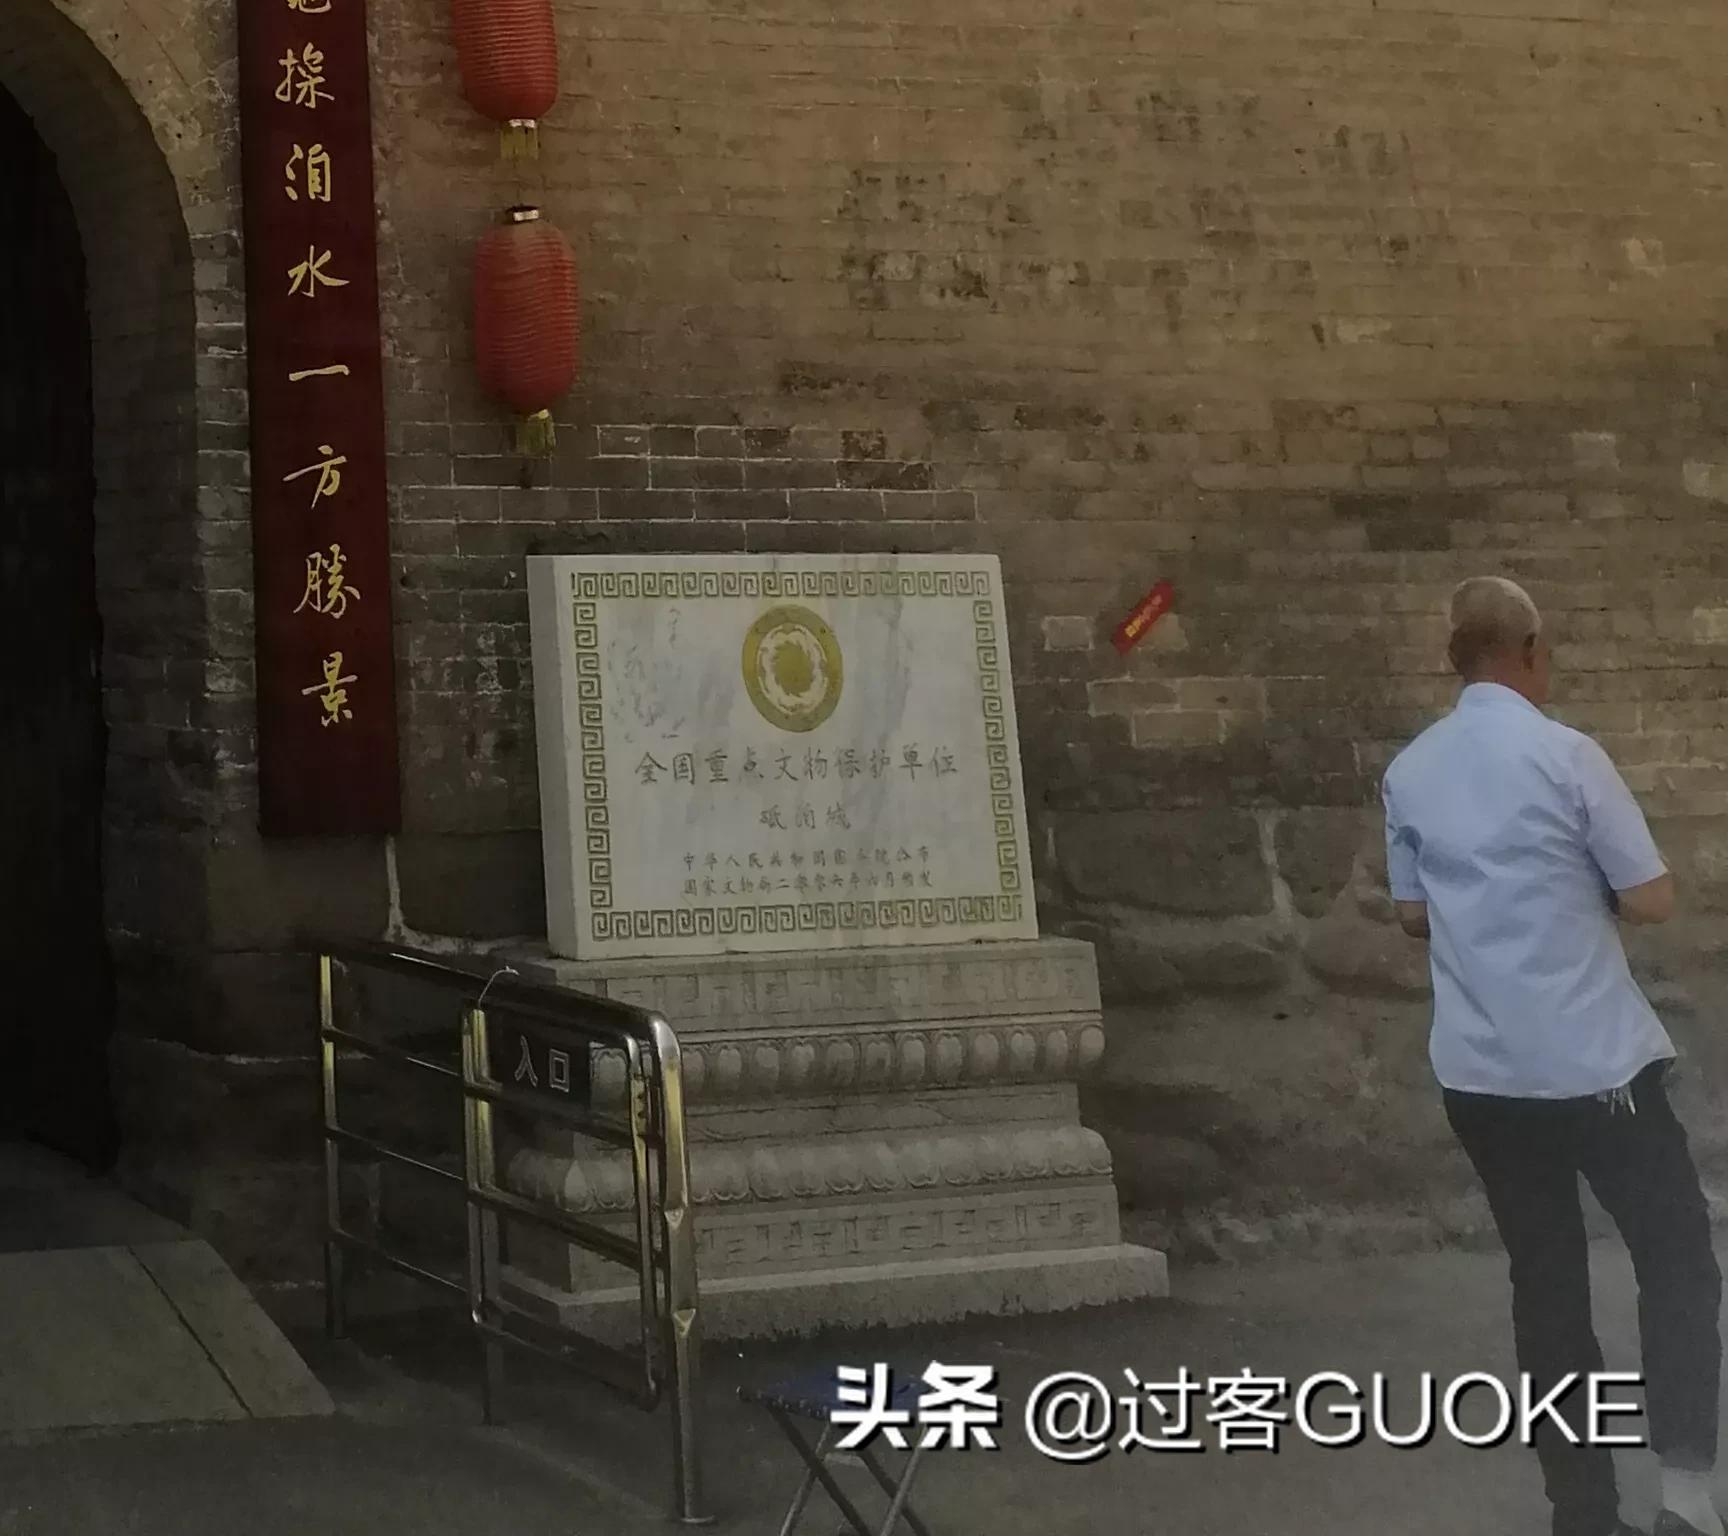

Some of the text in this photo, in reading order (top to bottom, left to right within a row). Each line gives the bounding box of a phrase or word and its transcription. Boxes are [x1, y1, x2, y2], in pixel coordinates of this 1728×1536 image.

[634, 742, 960, 785] 全国重点文物保护单位
[513, 1034, 570, 1094] 入口
